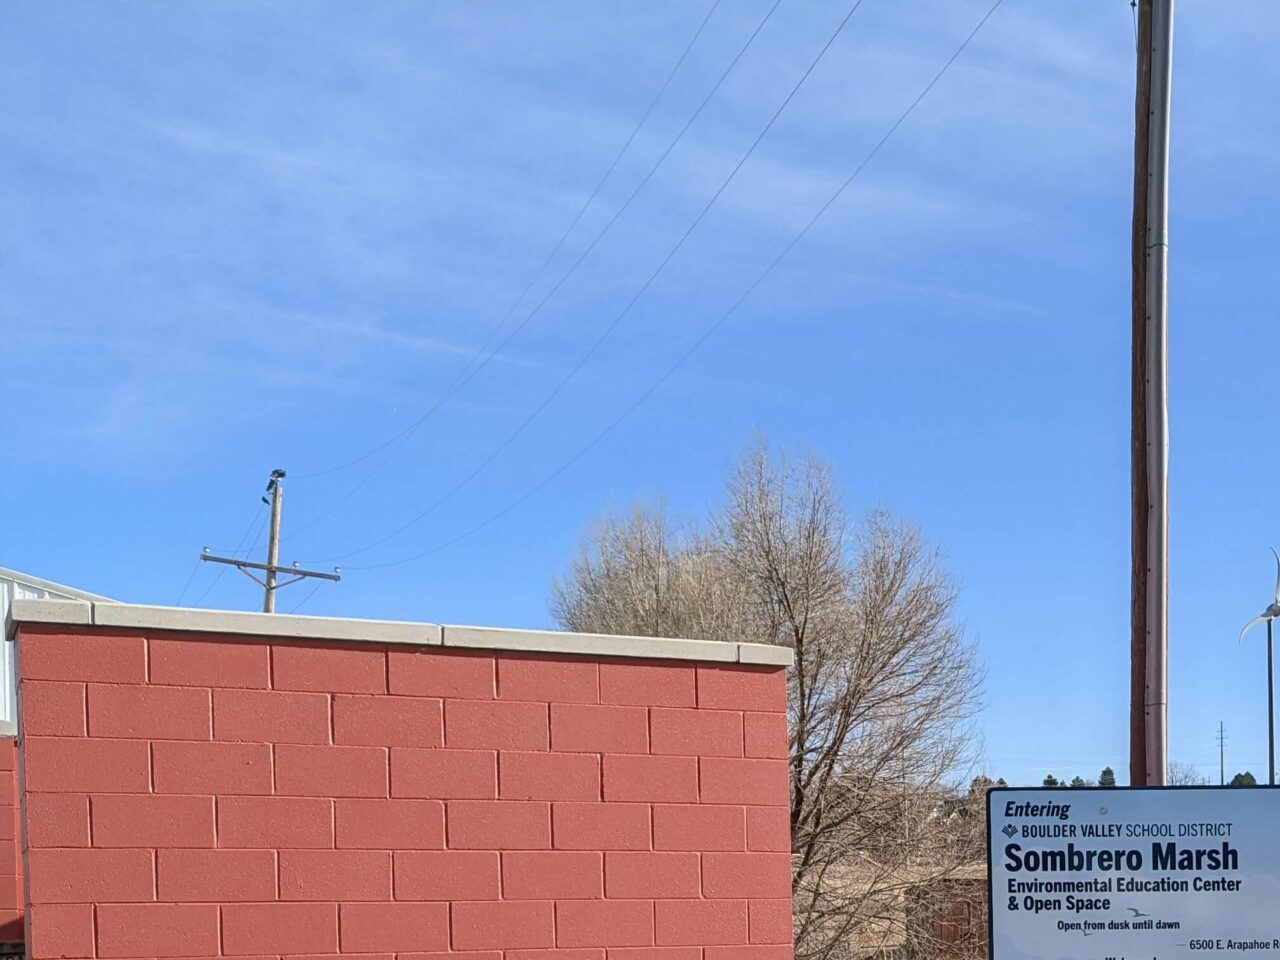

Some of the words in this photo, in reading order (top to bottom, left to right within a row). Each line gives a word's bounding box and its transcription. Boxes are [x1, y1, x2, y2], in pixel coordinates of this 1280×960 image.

[1005, 801, 1070, 820] Entering
[1022, 824, 1076, 838] BOULDER
[1081, 824, 1122, 837] VALLEY
[1126, 824, 1175, 837] SCHOOL
[1179, 823, 1232, 836] DISTRICT
[1005, 843, 1142, 872] Sombrero
[1152, 842, 1238, 870] Marsh
[1008, 878, 1112, 893] Environmental
[1117, 877, 1188, 892] Education
[1193, 877, 1241, 891] Center
[1008, 896, 1019, 911] &
[1024, 896, 1061, 914] Open
[1066, 895, 1110, 913] Space
[1058, 920, 1082, 932] Open
[1084, 920, 1105, 930] from
[1108, 920, 1130, 930] dusk
[1132, 920, 1153, 929] until
[1156, 920, 1180, 929] dawn
[1190, 940, 1214, 950] 6500
[1216, 940, 1224, 949] E.
[1227, 939, 1270, 951] Arapahoe
